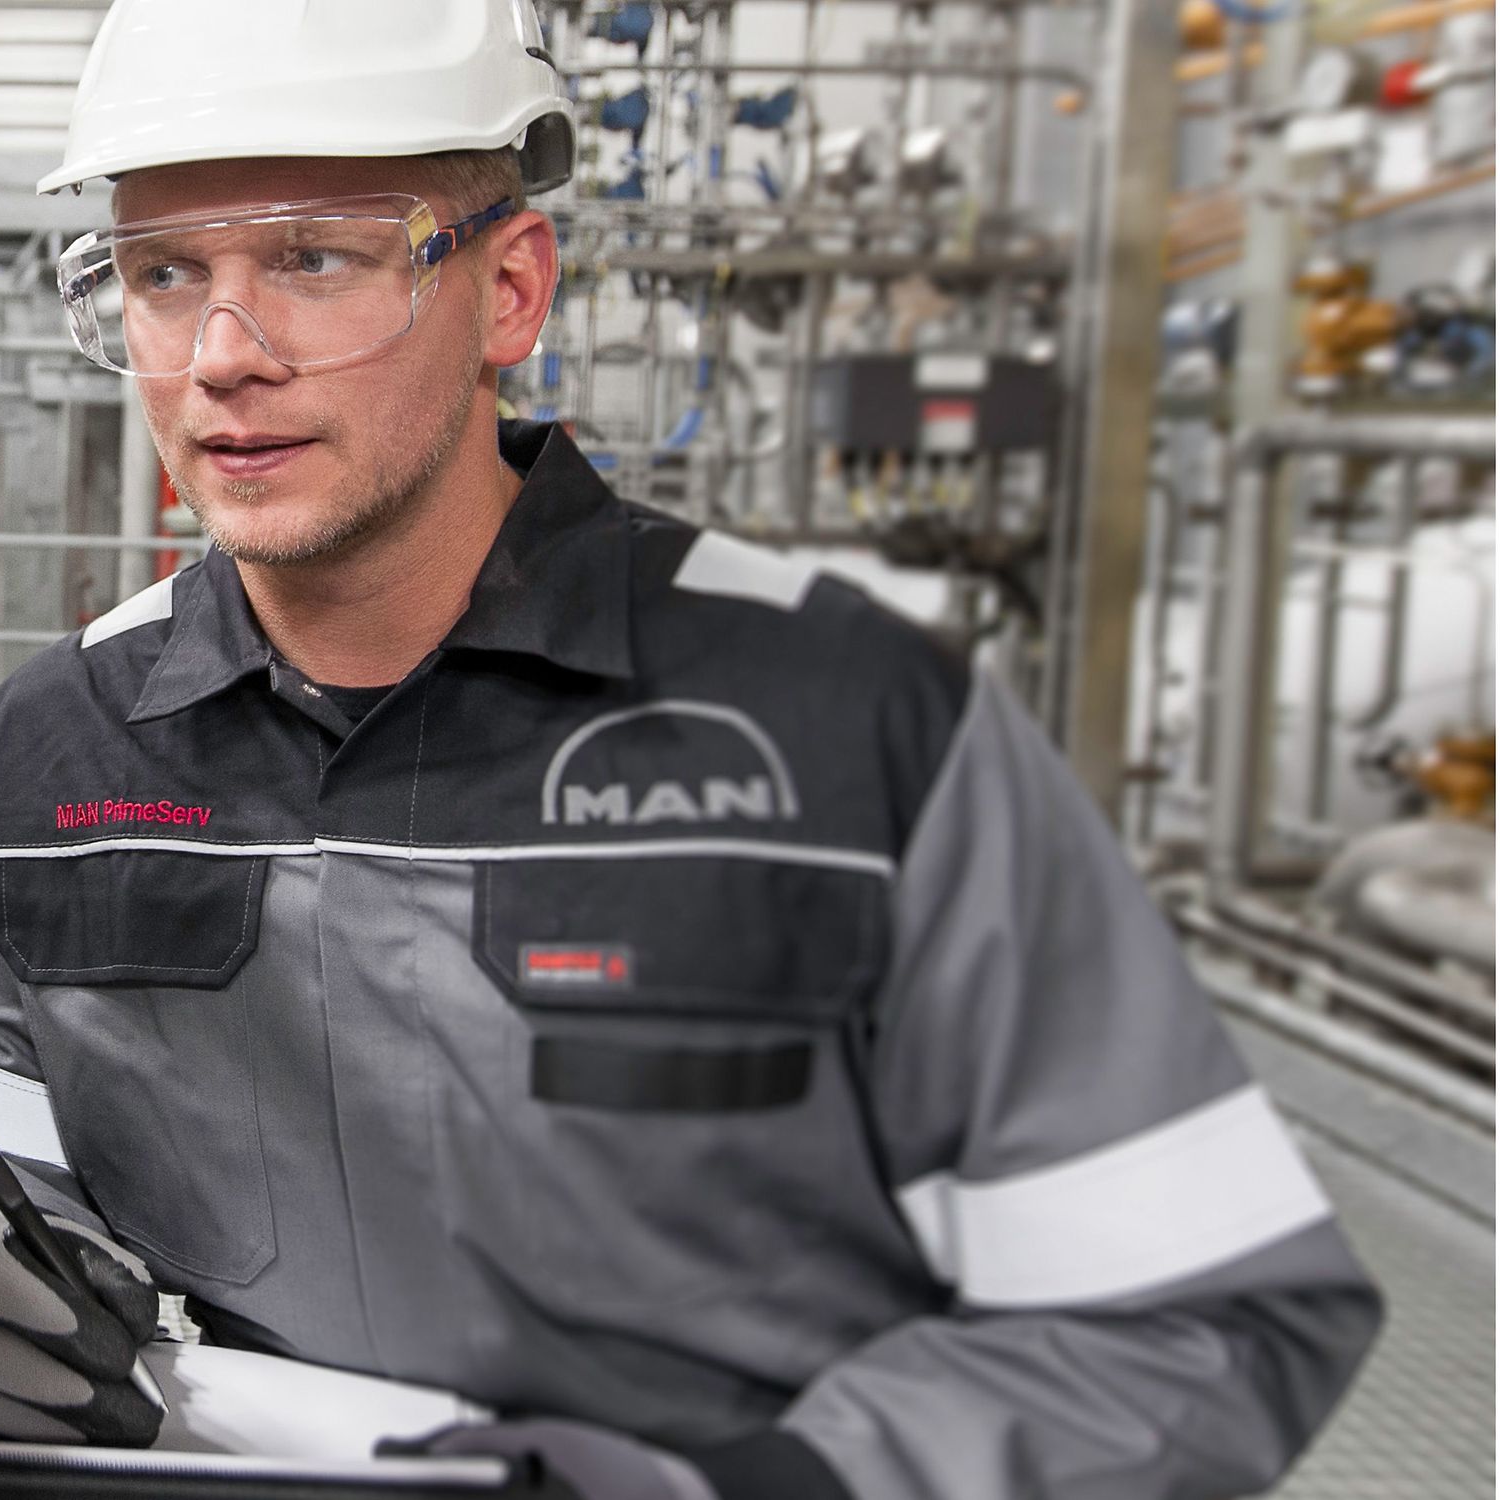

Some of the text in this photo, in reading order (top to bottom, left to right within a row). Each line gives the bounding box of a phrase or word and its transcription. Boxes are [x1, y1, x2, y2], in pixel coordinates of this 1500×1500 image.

[56, 798, 212, 829] MAN PrimeServ
[563, 777, 773, 825] MAN
